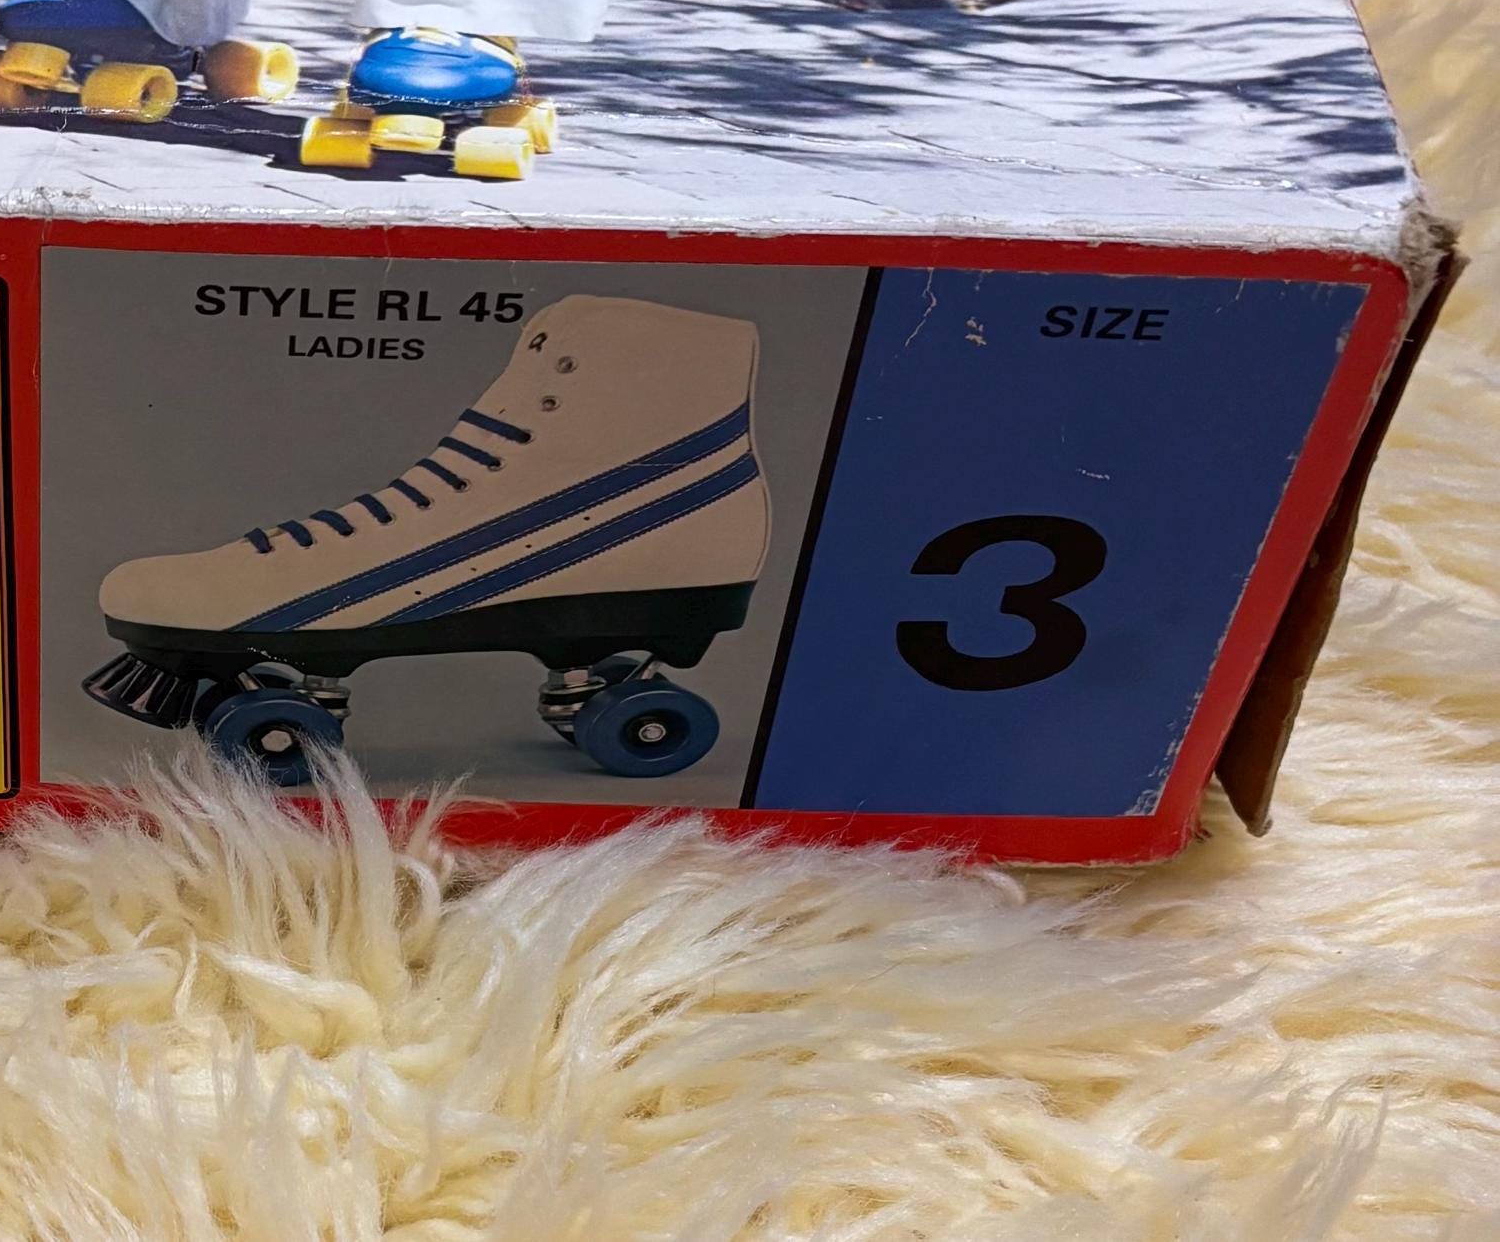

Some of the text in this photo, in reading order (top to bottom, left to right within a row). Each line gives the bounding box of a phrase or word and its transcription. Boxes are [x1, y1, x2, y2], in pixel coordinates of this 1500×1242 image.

[194, 283, 525, 324] STYLE RL 45
[1040, 304, 1170, 343] SIZE
[287, 335, 426, 362] LADIES
[896, 515, 1108, 691] 3
